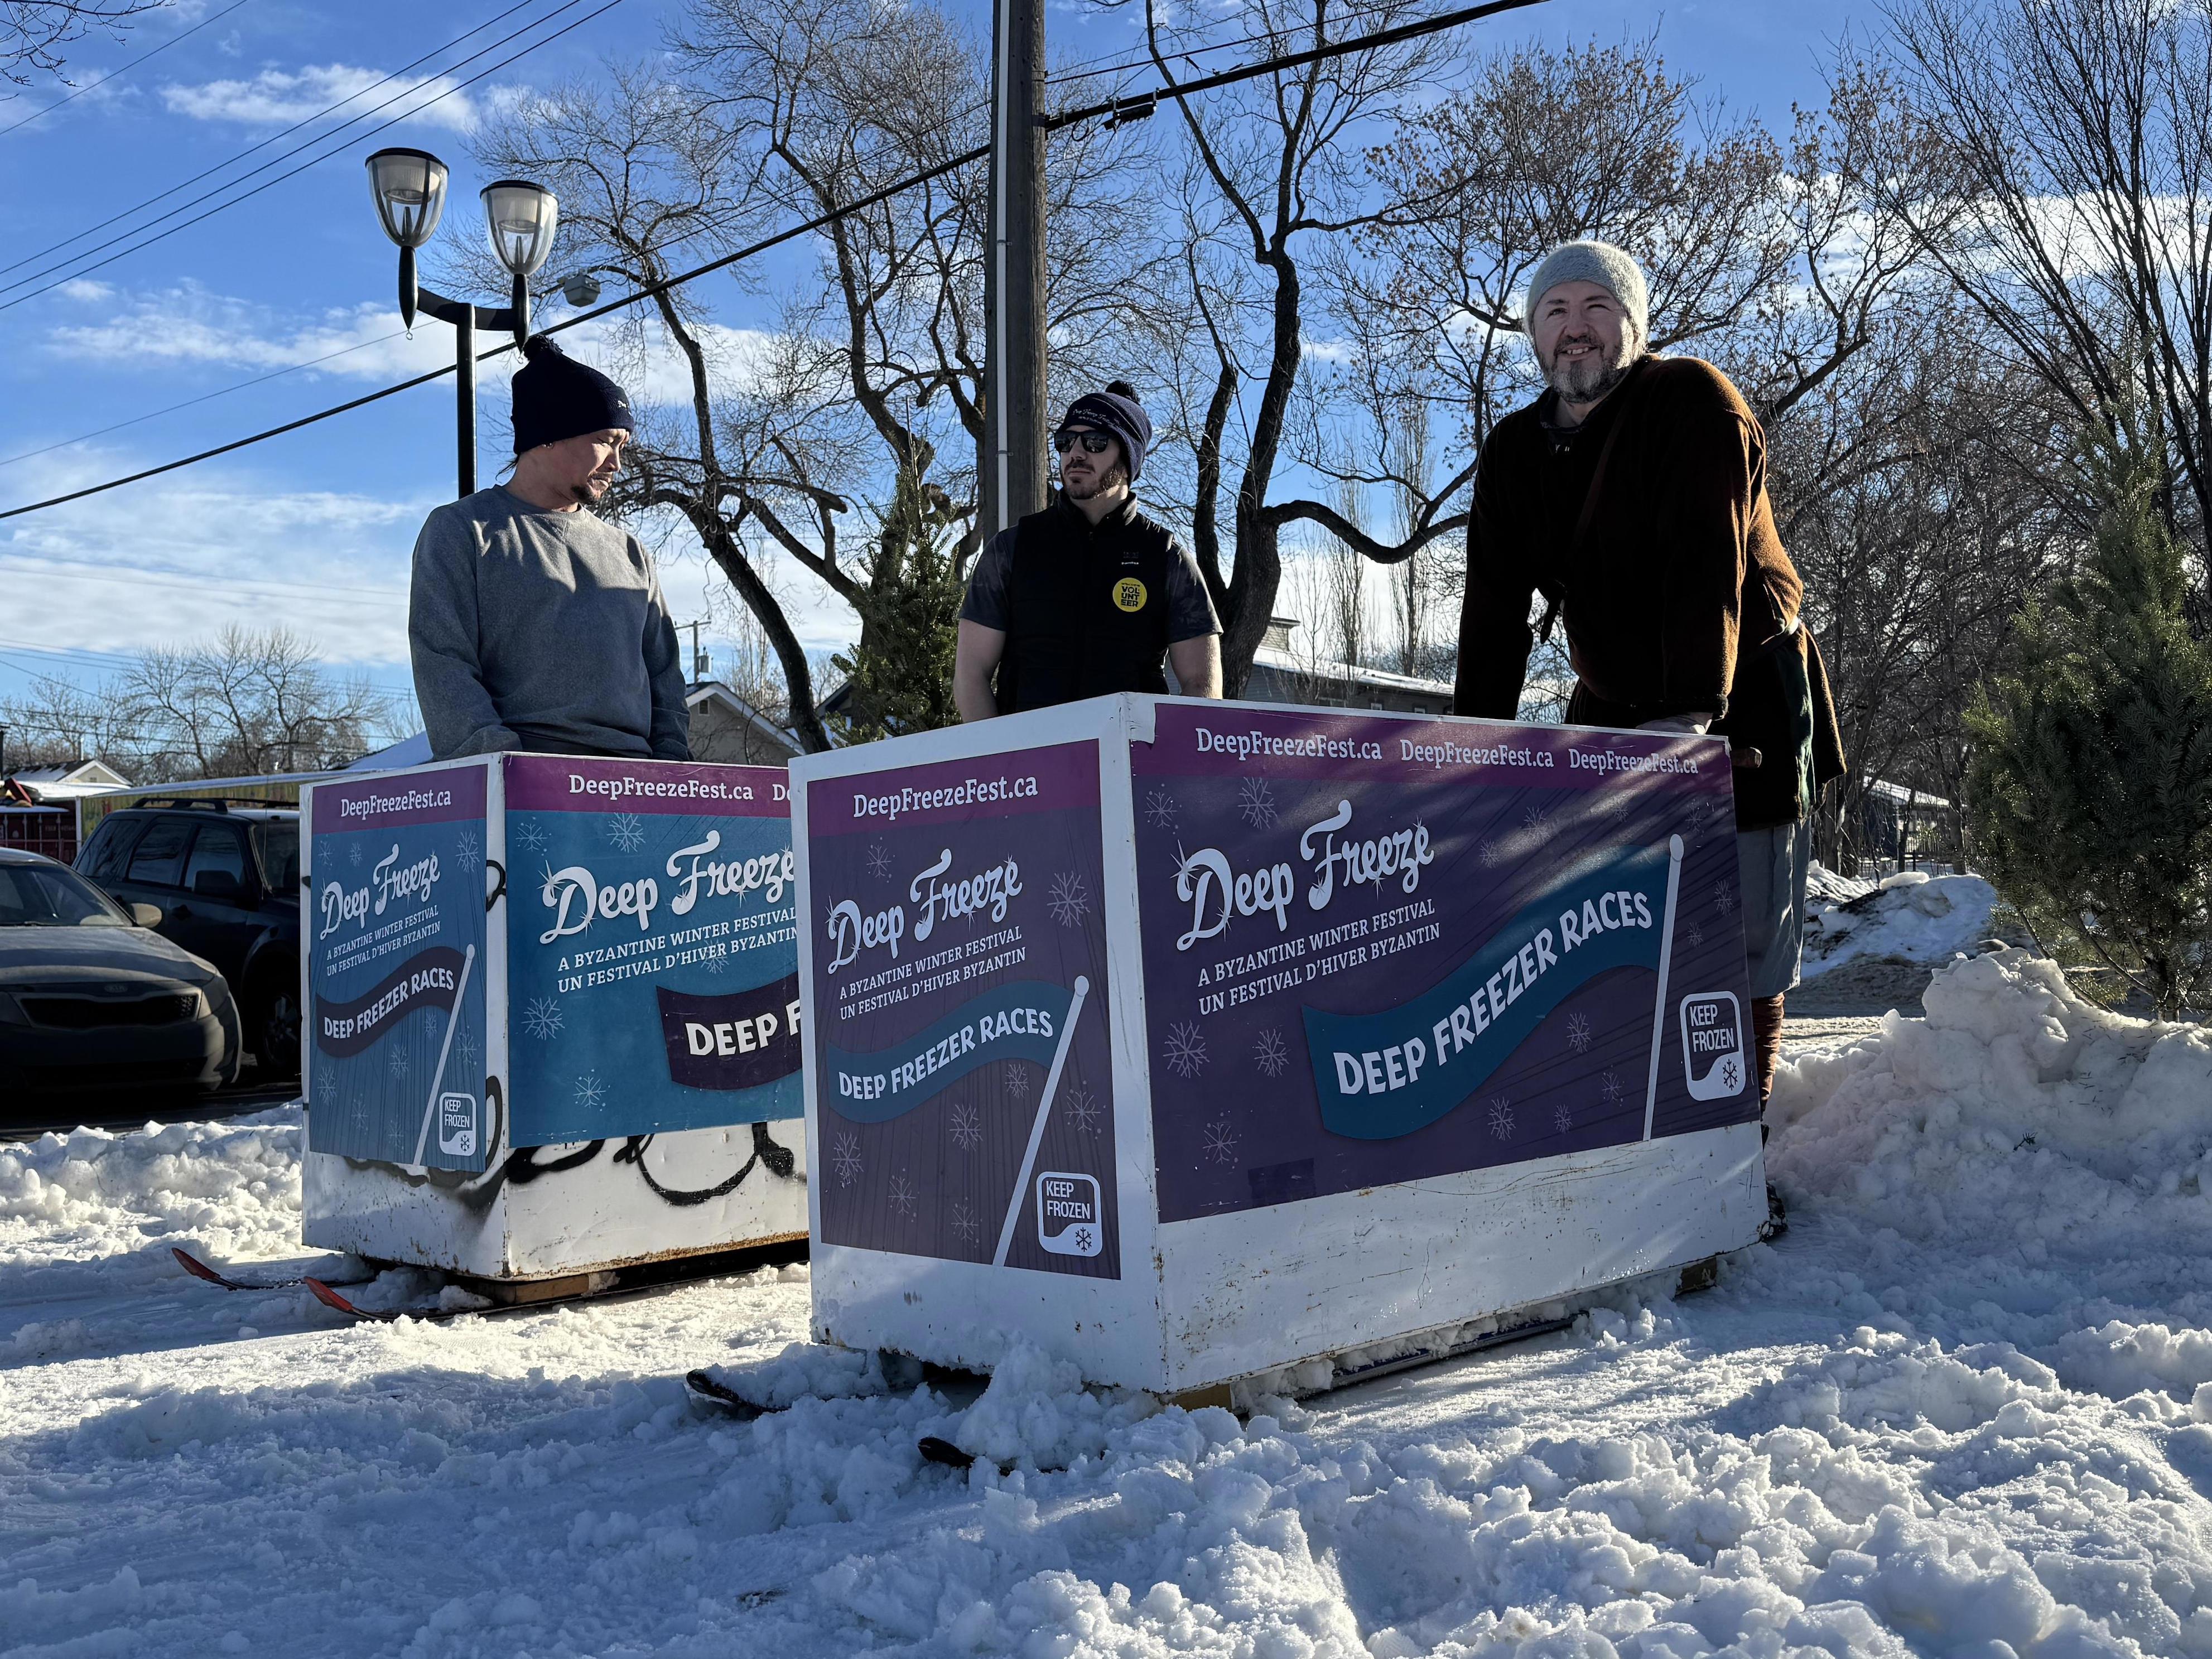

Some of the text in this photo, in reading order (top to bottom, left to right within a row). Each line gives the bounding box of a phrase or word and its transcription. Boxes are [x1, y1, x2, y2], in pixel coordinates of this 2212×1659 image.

[1196, 727, 1698, 776] DeepFreezeFest.ca DeepFreezeFest.ca DeepFreezeFest.ca
[341, 789, 451, 820] DeepFreezeFest.ca
[569, 774, 754, 800] DeepFreezeFest.ca
[853, 776, 1038, 821] DeepFreezeFest.ca
[320, 843, 440, 940] Deep Freeze
[540, 830, 794, 943] Deep Freeze
[1177, 799, 1434, 951] Deep Freeze
[327, 905, 438, 960] A BYZANTINE WINTER FESTIVAL
[828, 848, 1023, 975] Deep Freeze
[327, 922, 440, 976] UN FESTIVAL D'HIVER BYZANTIN
[558, 907, 796, 972] A BYZANTINE WINTER FESTIVAL
[840, 926, 1022, 1000] A BYZANTINE WINTER FESTIVAL
[1198, 898, 1435, 987] A BYZANTINE WINTER FESTIVAL
[558, 978, 582, 992] UN
[587, 958, 661, 987] FESTIVAL
[840, 1006, 856, 1020] UN
[858, 986, 909, 1015] FESTIVAL
[963, 947, 1027, 980] BYZANTIN
[1199, 992, 1224, 1016] UN
[1230, 967, 1303, 1007] FESTIVAL
[1371, 922, 1440, 959] BYZANTIN
[1333, 891, 1652, 1095] DEEP FREEZER RACES
[324, 967, 454, 1039] DEEP FREEZER RACES
[1690, 1004, 1718, 1026] KEEP
[685, 1012, 778, 1056] DEEP
[839, 1008, 1054, 1099] DEEP FREEZER RACES
[1692, 1028, 1735, 1052] FROZEN
[445, 1099, 461, 1112] KEEP
[445, 1114, 470, 1128] FROZEN
[1046, 1180, 1074, 1198] KEEP
[1047, 1200, 1091, 1219] FROZEN
